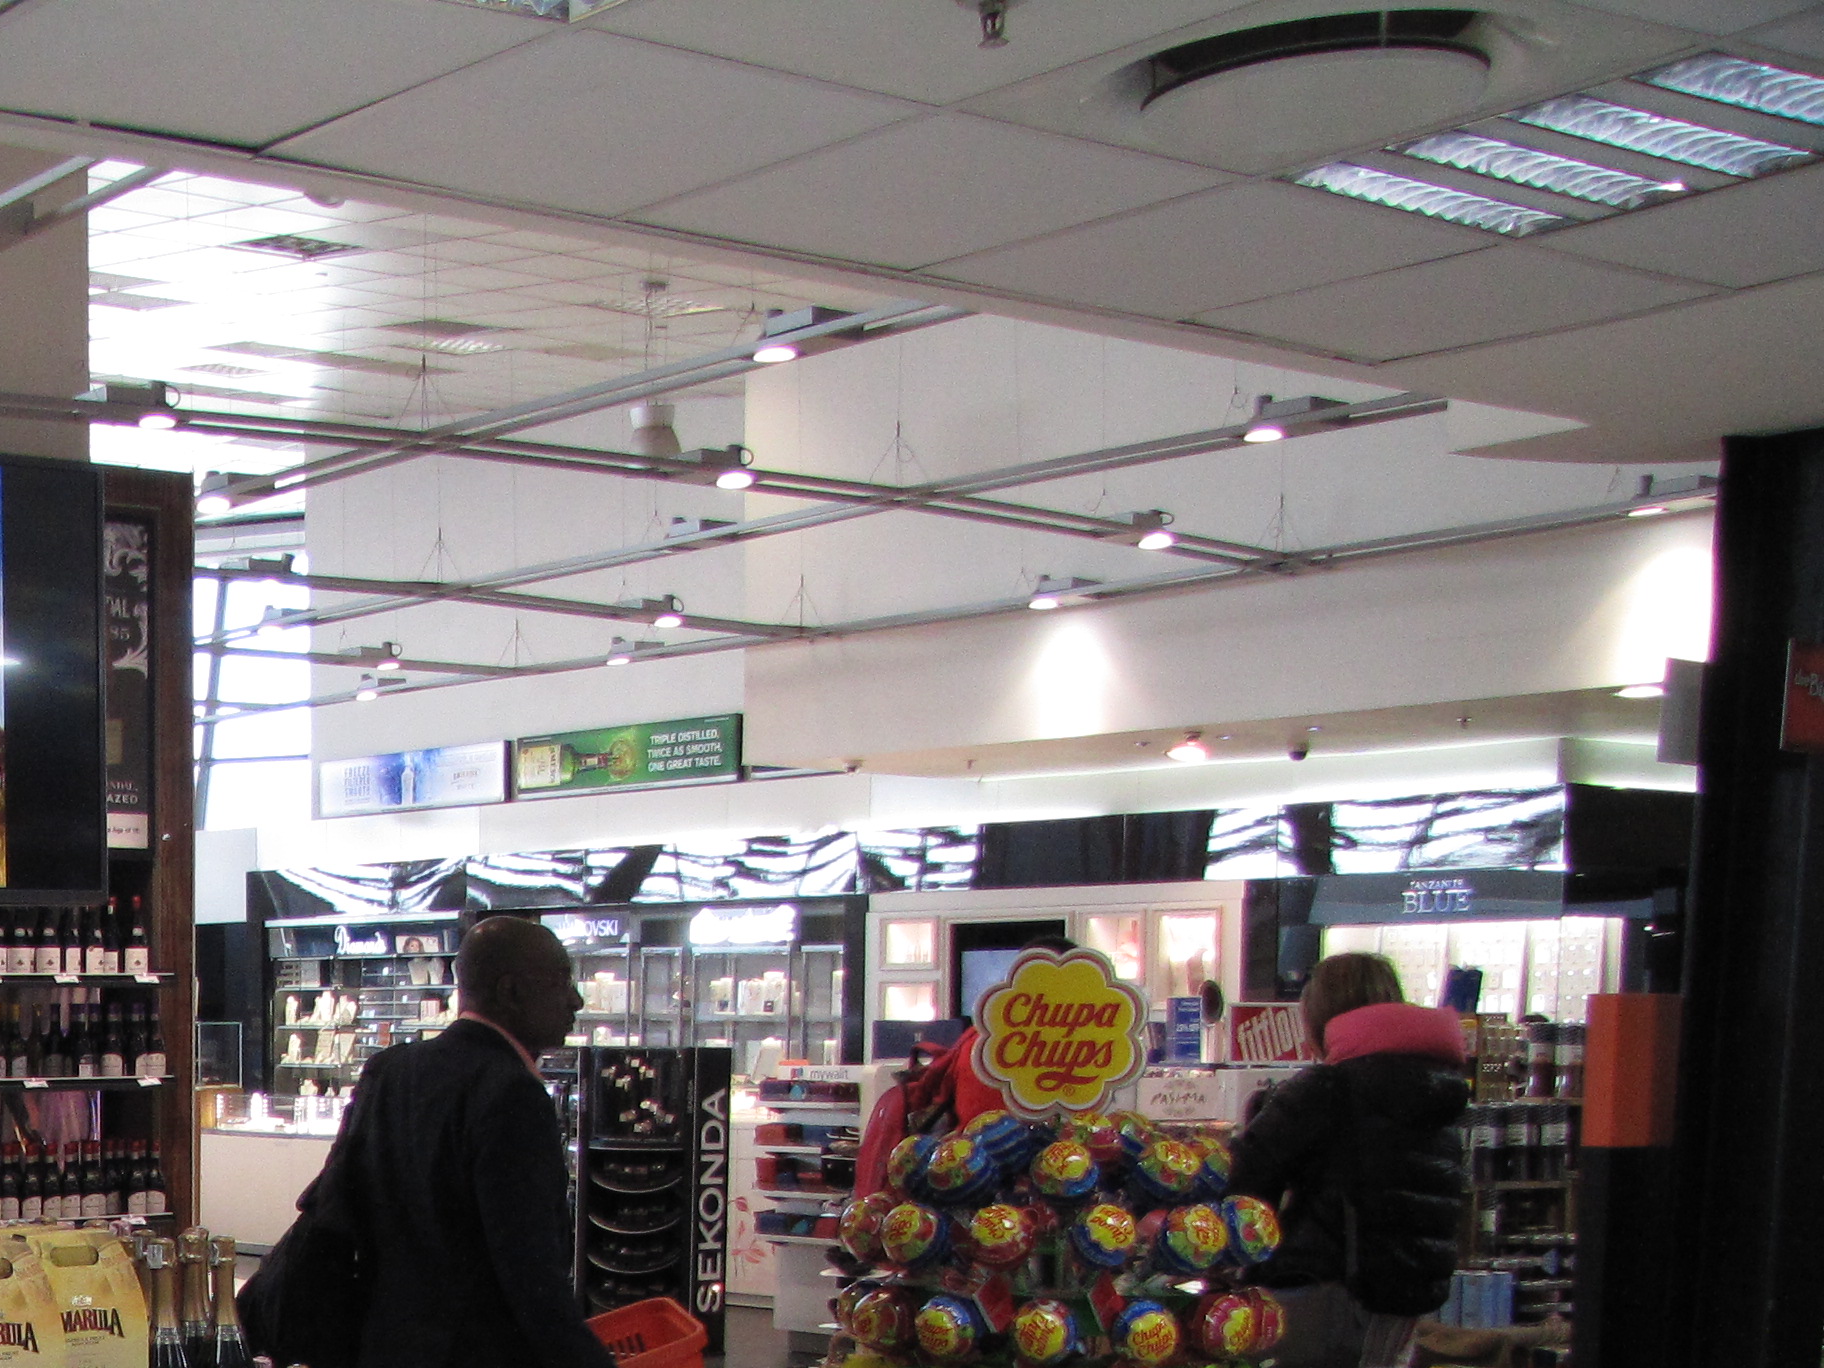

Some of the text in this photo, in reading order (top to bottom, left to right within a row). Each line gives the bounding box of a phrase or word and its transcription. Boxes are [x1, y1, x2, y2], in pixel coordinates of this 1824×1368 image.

[1402, 889, 1472, 914] BLUE
[1002, 993, 1122, 1038] Chupa
[995, 1030, 1114, 1092] Chups
[696, 1087, 726, 1313] SEKONDA
[60, 1308, 125, 1338] MARULA
